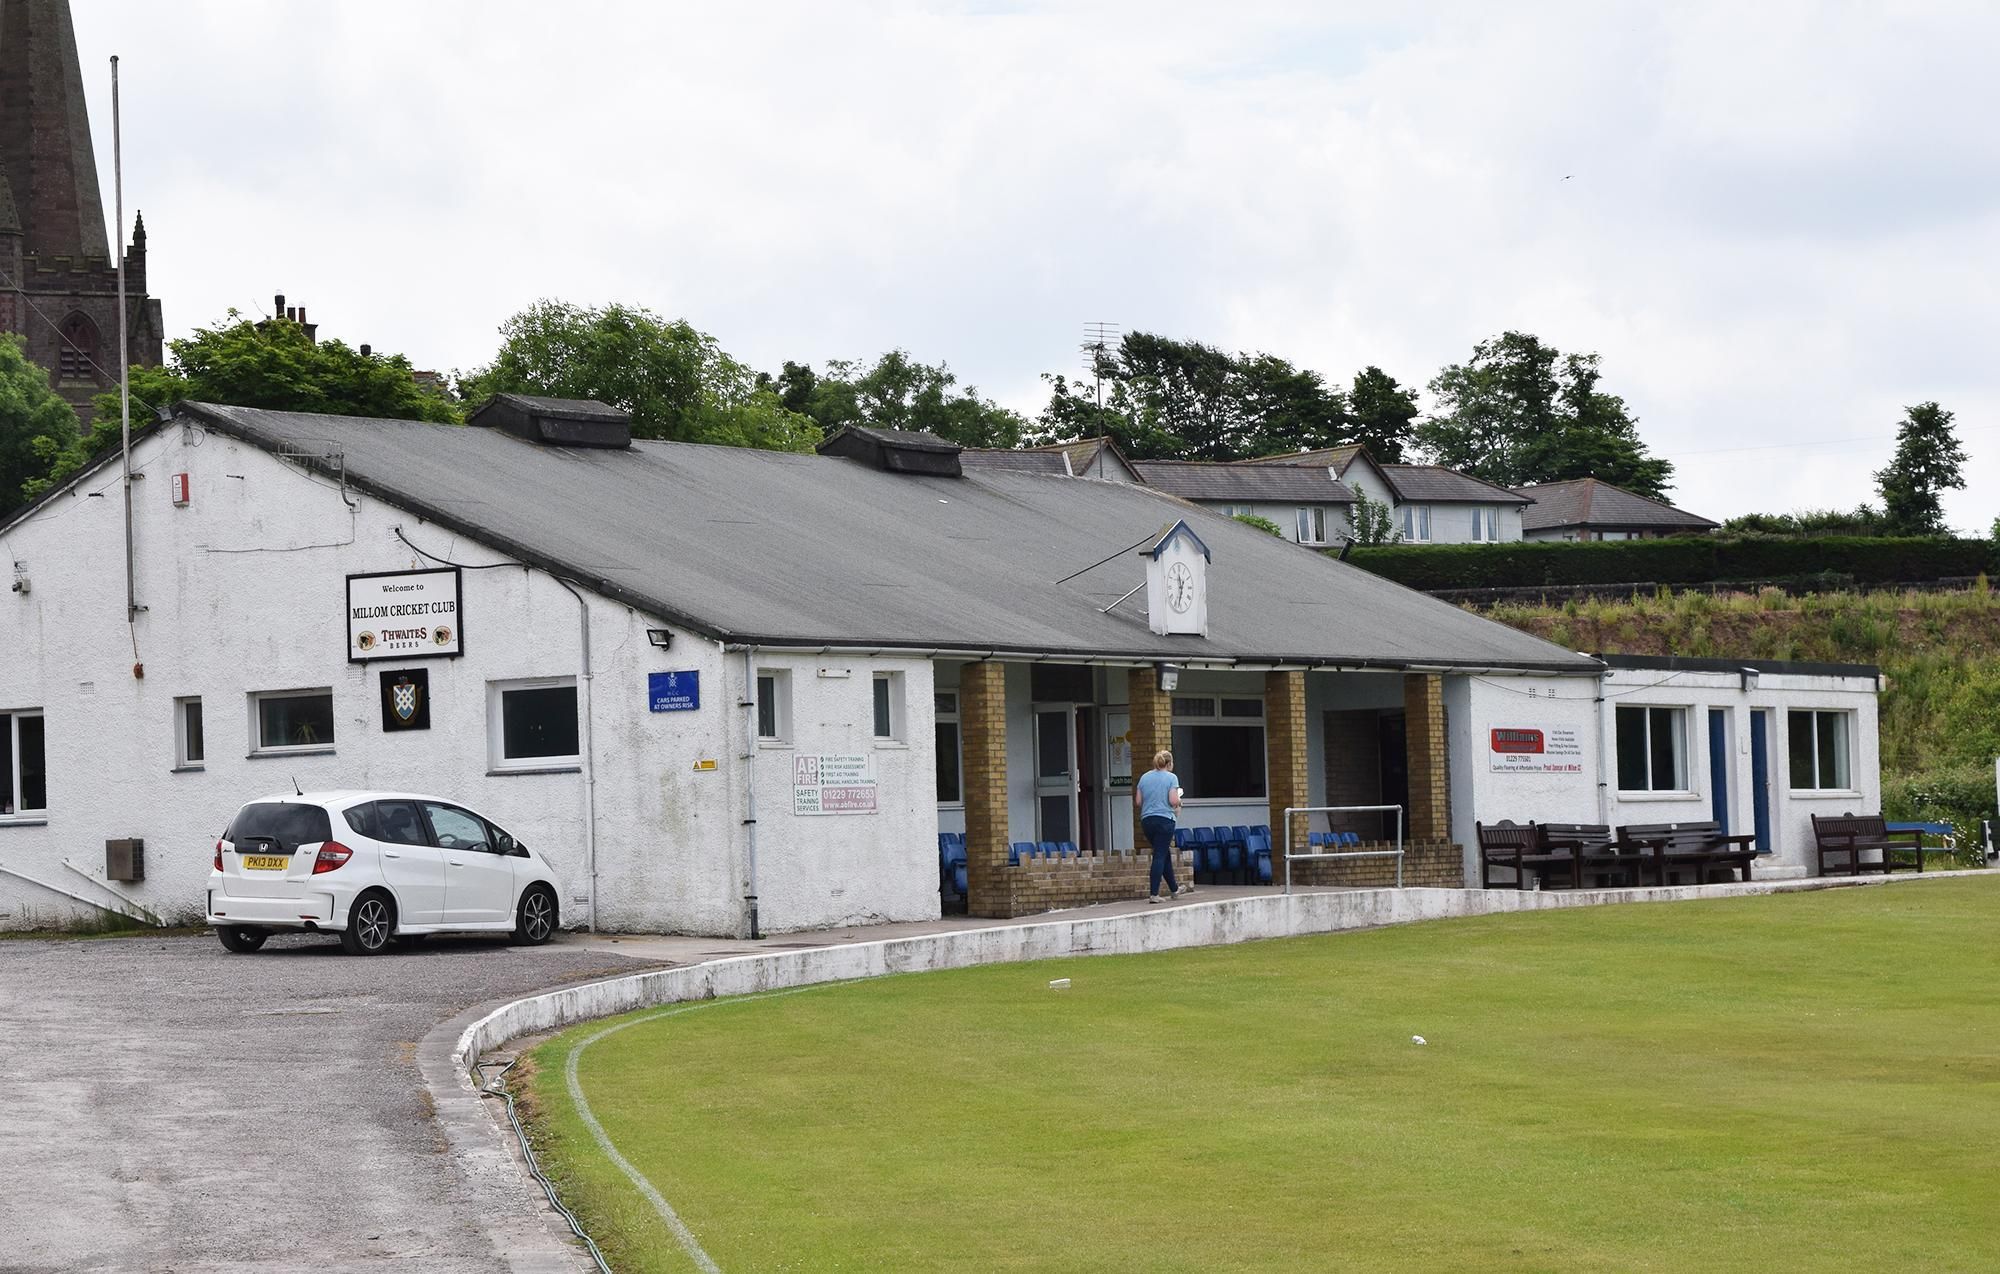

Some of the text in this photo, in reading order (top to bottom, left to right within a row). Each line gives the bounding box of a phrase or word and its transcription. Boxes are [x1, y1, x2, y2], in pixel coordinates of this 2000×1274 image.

[352, 601, 455, 619] MILLOM CRICKET CLUB
[381, 627, 427, 642] THWAITES
[1496, 731, 1539, 742] Williams
[797, 758, 817, 774] AB
[797, 774, 817, 784] FIRE
[796, 789, 818, 797] SAFETY
[823, 790, 846, 799] 01229
[248, 857, 284, 867] PK13 DXX
